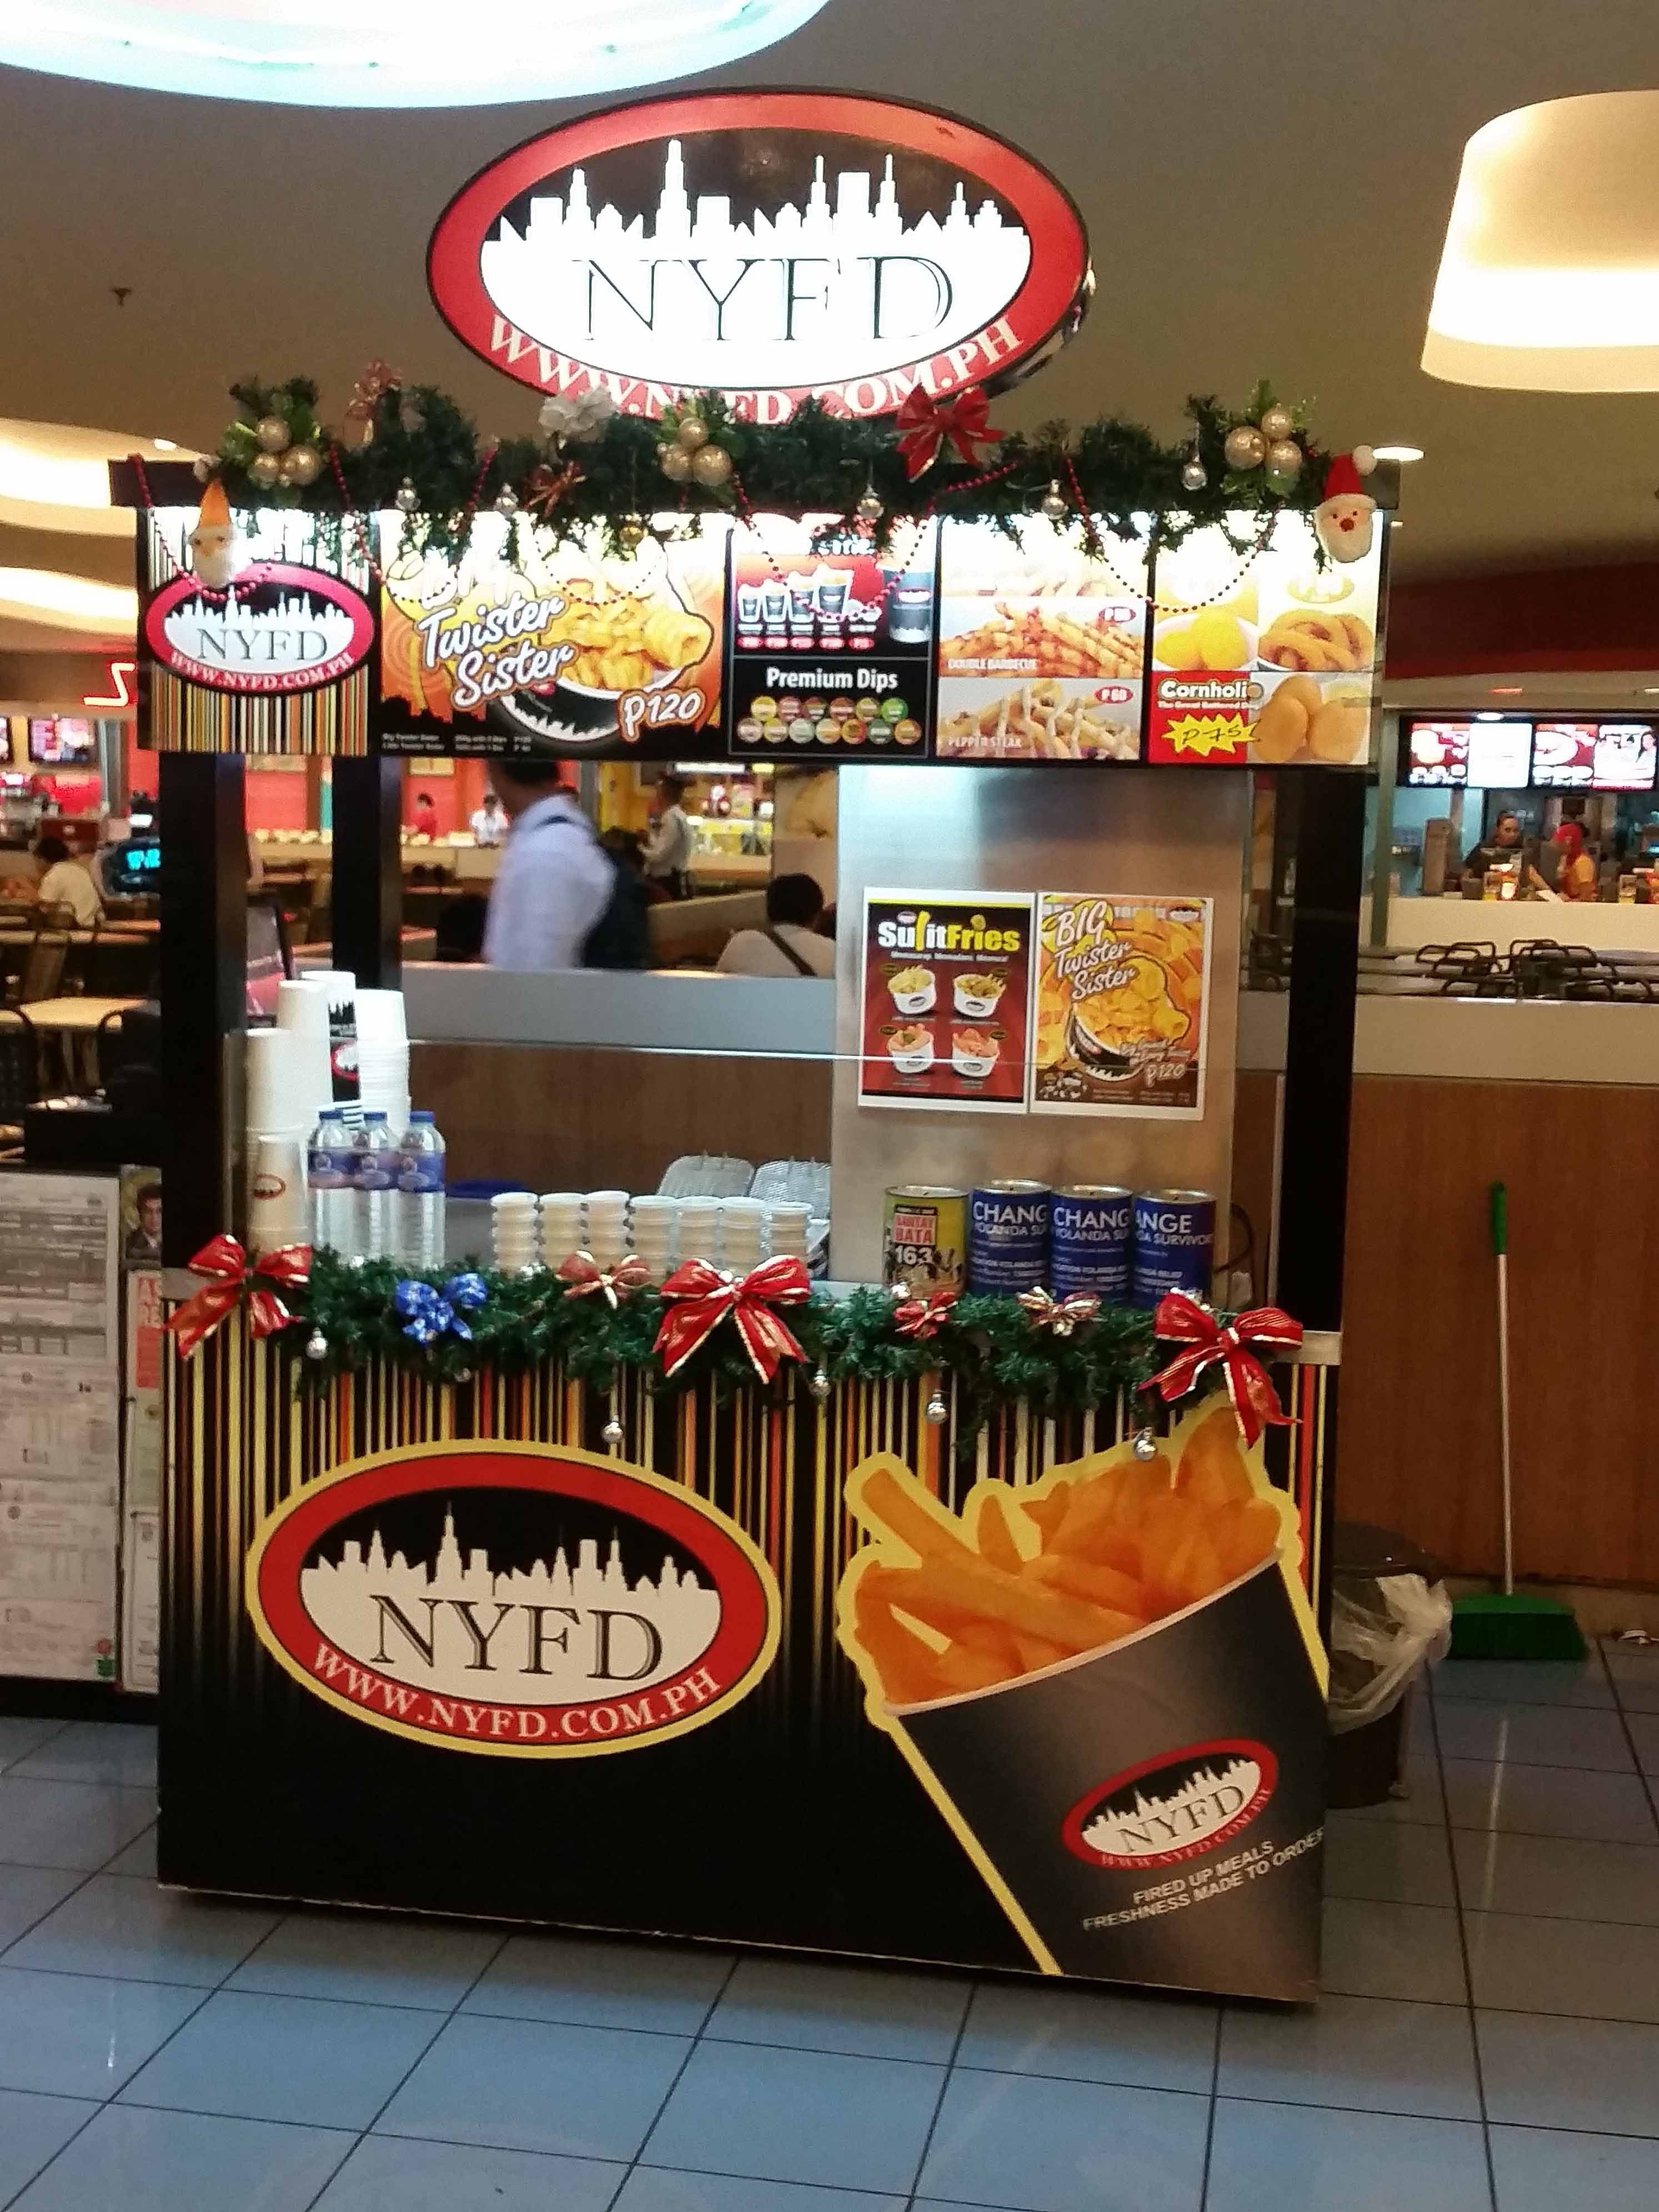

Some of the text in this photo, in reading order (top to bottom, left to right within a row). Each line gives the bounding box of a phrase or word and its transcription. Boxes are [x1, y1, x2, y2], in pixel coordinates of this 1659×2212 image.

[572, 257, 953, 340] NYFD
[490, 313, 1023, 425] WWW.NFDOM.PH
[197, 628, 328, 660] NYFD
[418, 591, 565, 667] Twister
[454, 640, 574, 706] Sister
[767, 666, 898, 693] Premium Dips
[624, 692, 701, 737] P120
[1057, 901, 1107, 946] BIG
[1055, 939, 1132, 978] Twister
[1072, 966, 1135, 1000] Sister
[896, 1245, 933, 1265] 163
[369, 1594, 663, 1681] NYFD
[313, 1642, 721, 1738] WWW.NYFD.COM.PH
[1117, 1786, 1244, 1853] NYFD
[1083, 1893, 1191, 1931] FRESHNESS
[1193, 1872, 1244, 1901] MADE
[1248, 1860, 1270, 1879] TO
[1133, 1841, 1274, 1904] FIRED UP MEALS
